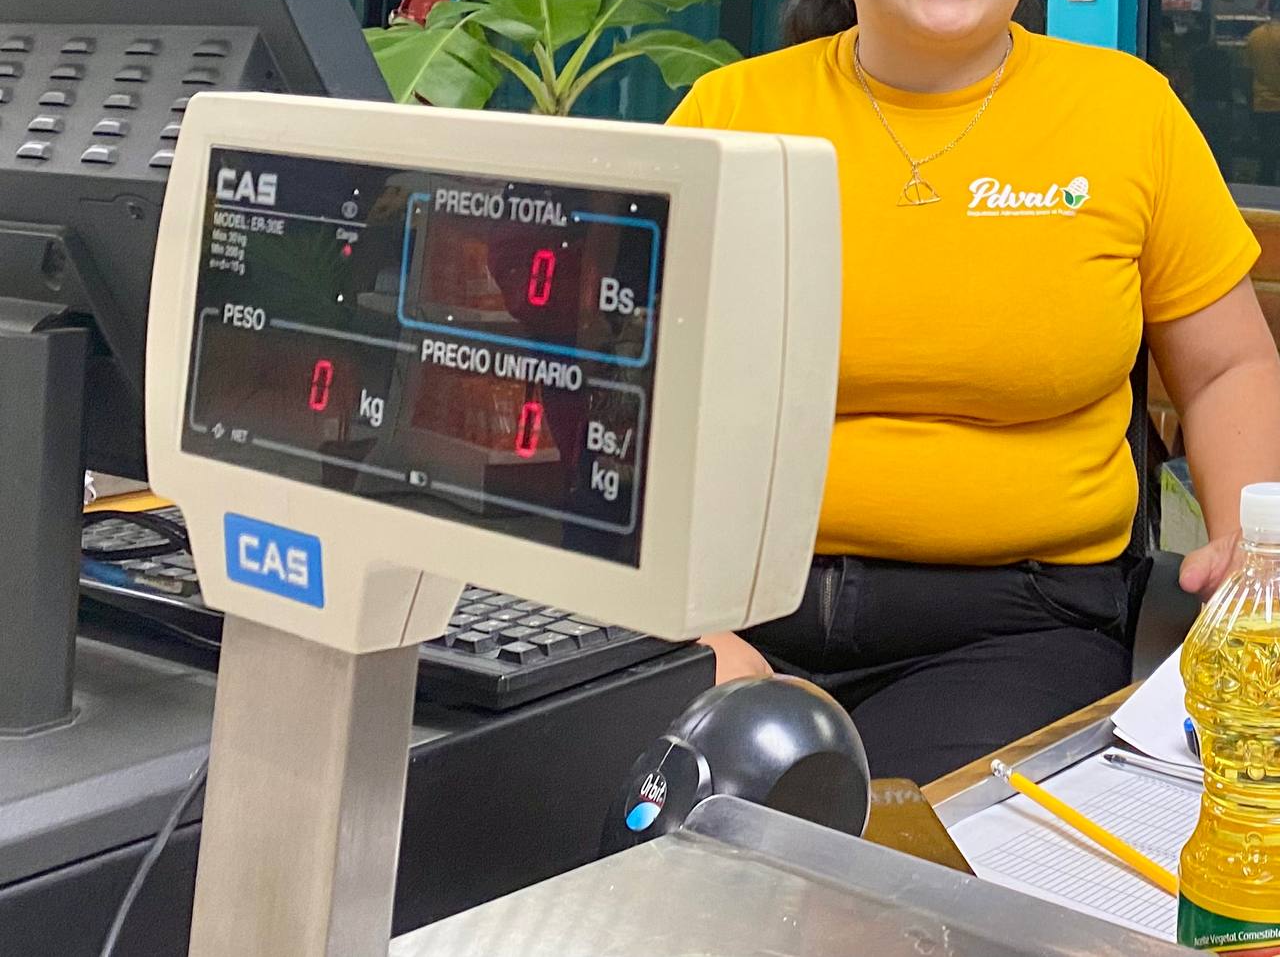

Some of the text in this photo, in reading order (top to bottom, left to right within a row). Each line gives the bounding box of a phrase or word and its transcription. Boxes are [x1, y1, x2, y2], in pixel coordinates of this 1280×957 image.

[216, 167, 278, 206] CAS
[968, 177, 1059, 209] Pdval
[434, 189, 568, 227] PRECIO TOTAL
[528, 249, 556, 306] 0
[600, 277, 642, 317] Bs.
[222, 303, 266, 330] PESO
[421, 339, 583, 390] PRECIO UNITARIO
[309, 359, 334, 411] 0
[359, 389, 385, 428] kg
[514, 401, 544, 458] 0
[586, 421, 632, 459] Bs./
[591, 460, 619, 501] kg
[239, 535, 309, 588] CAS
[1209, 930, 1237, 946] Vegetal
